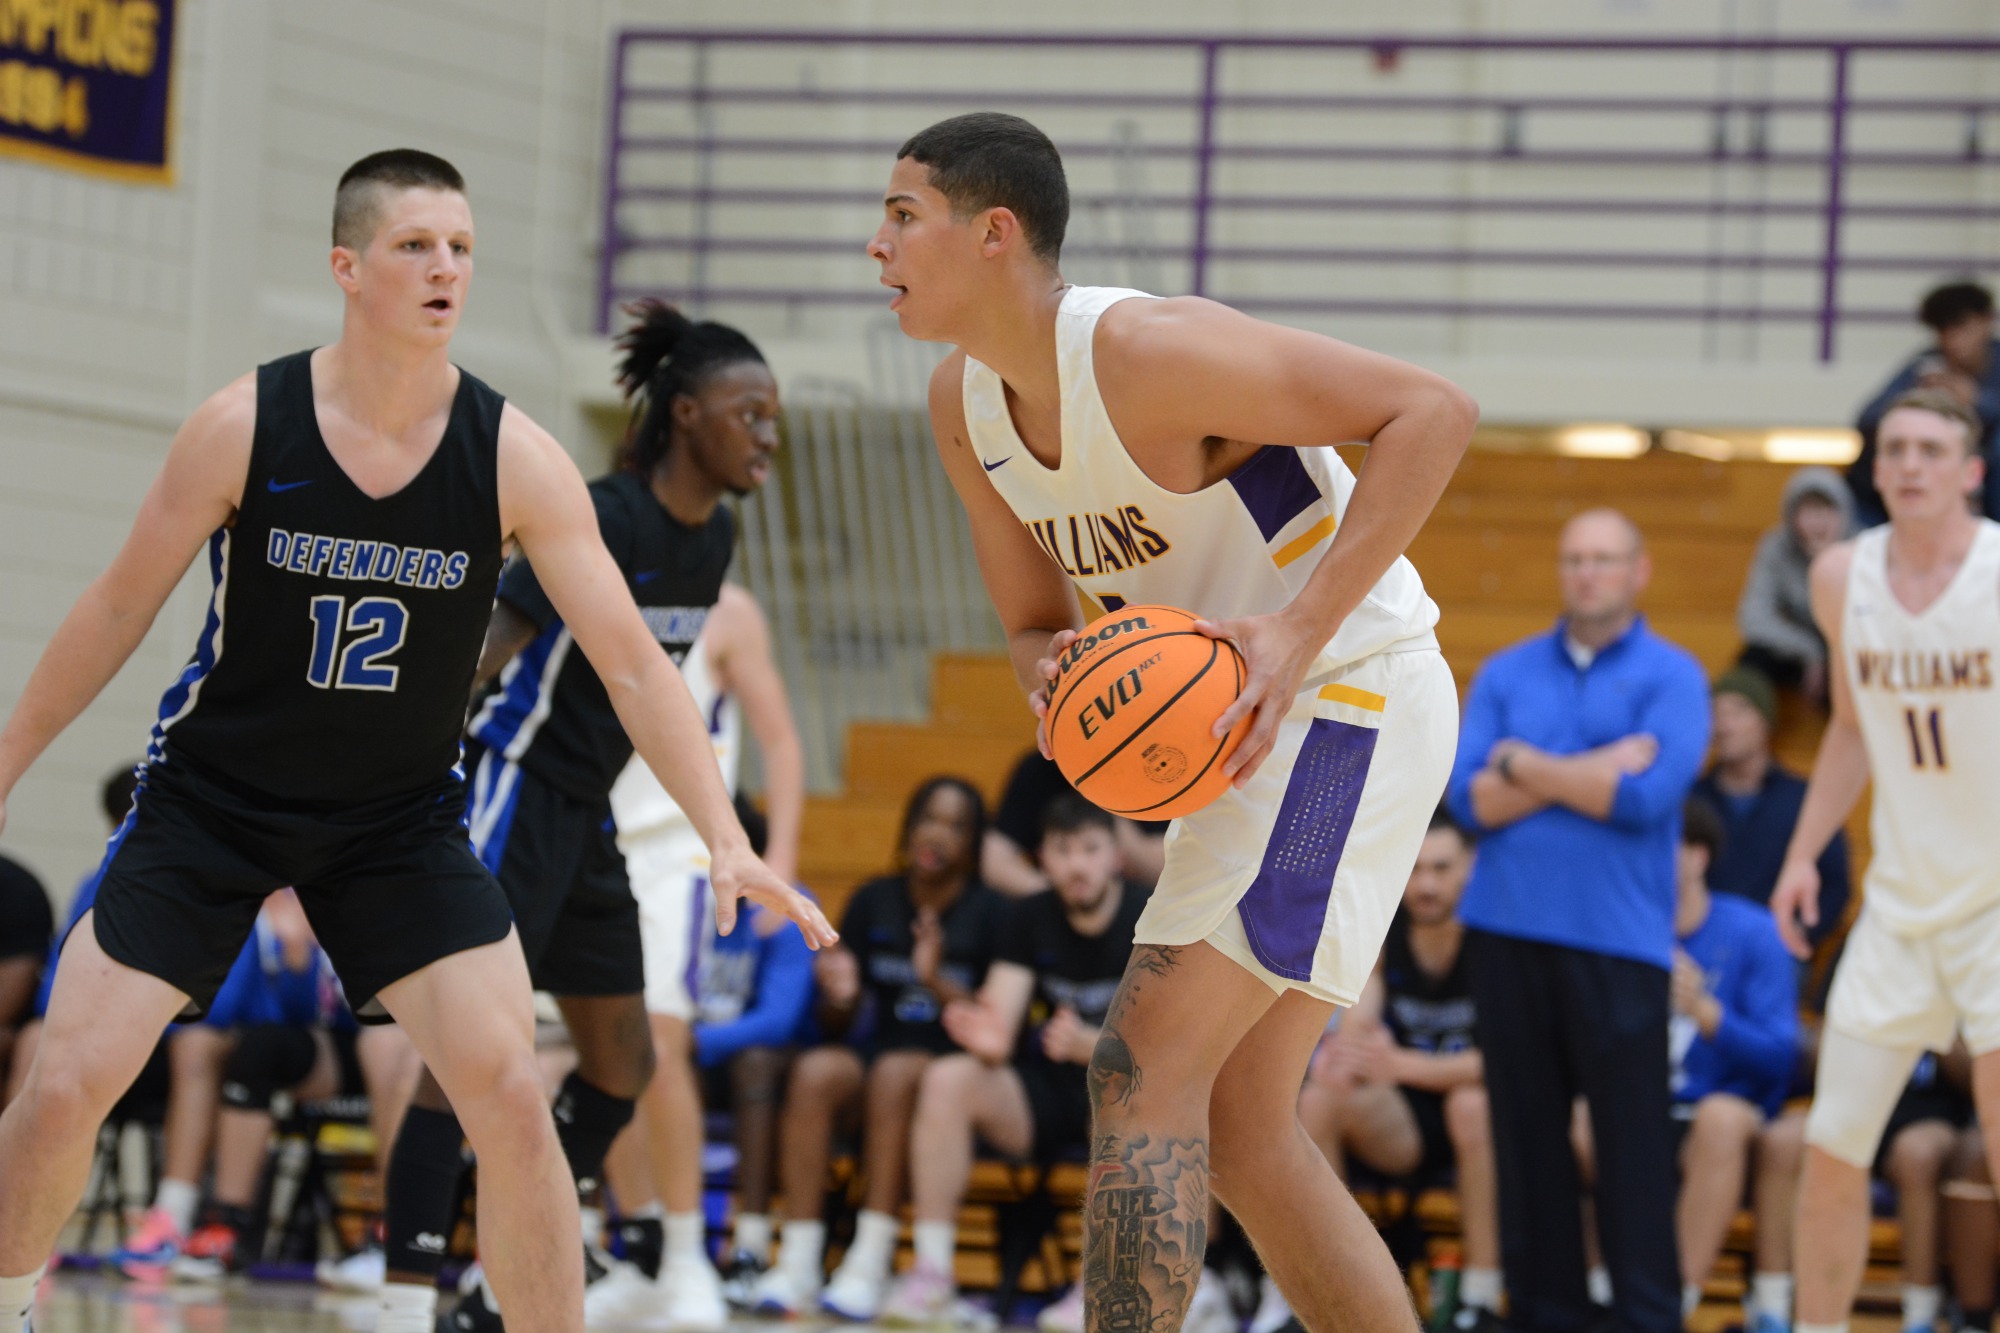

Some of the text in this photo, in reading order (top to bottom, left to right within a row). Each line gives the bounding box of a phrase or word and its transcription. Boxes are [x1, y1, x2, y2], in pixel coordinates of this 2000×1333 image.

[267, 527, 470, 590] DEFENDERS
[1023, 503, 1172, 578] ILLIAMS
[306, 594, 410, 692] 12
[1078, 667, 1143, 741] EVO
[1139, 651, 1162, 673] NXT
[1905, 707, 1949, 771] 11
[1106, 1187, 1159, 1216] LIFE
